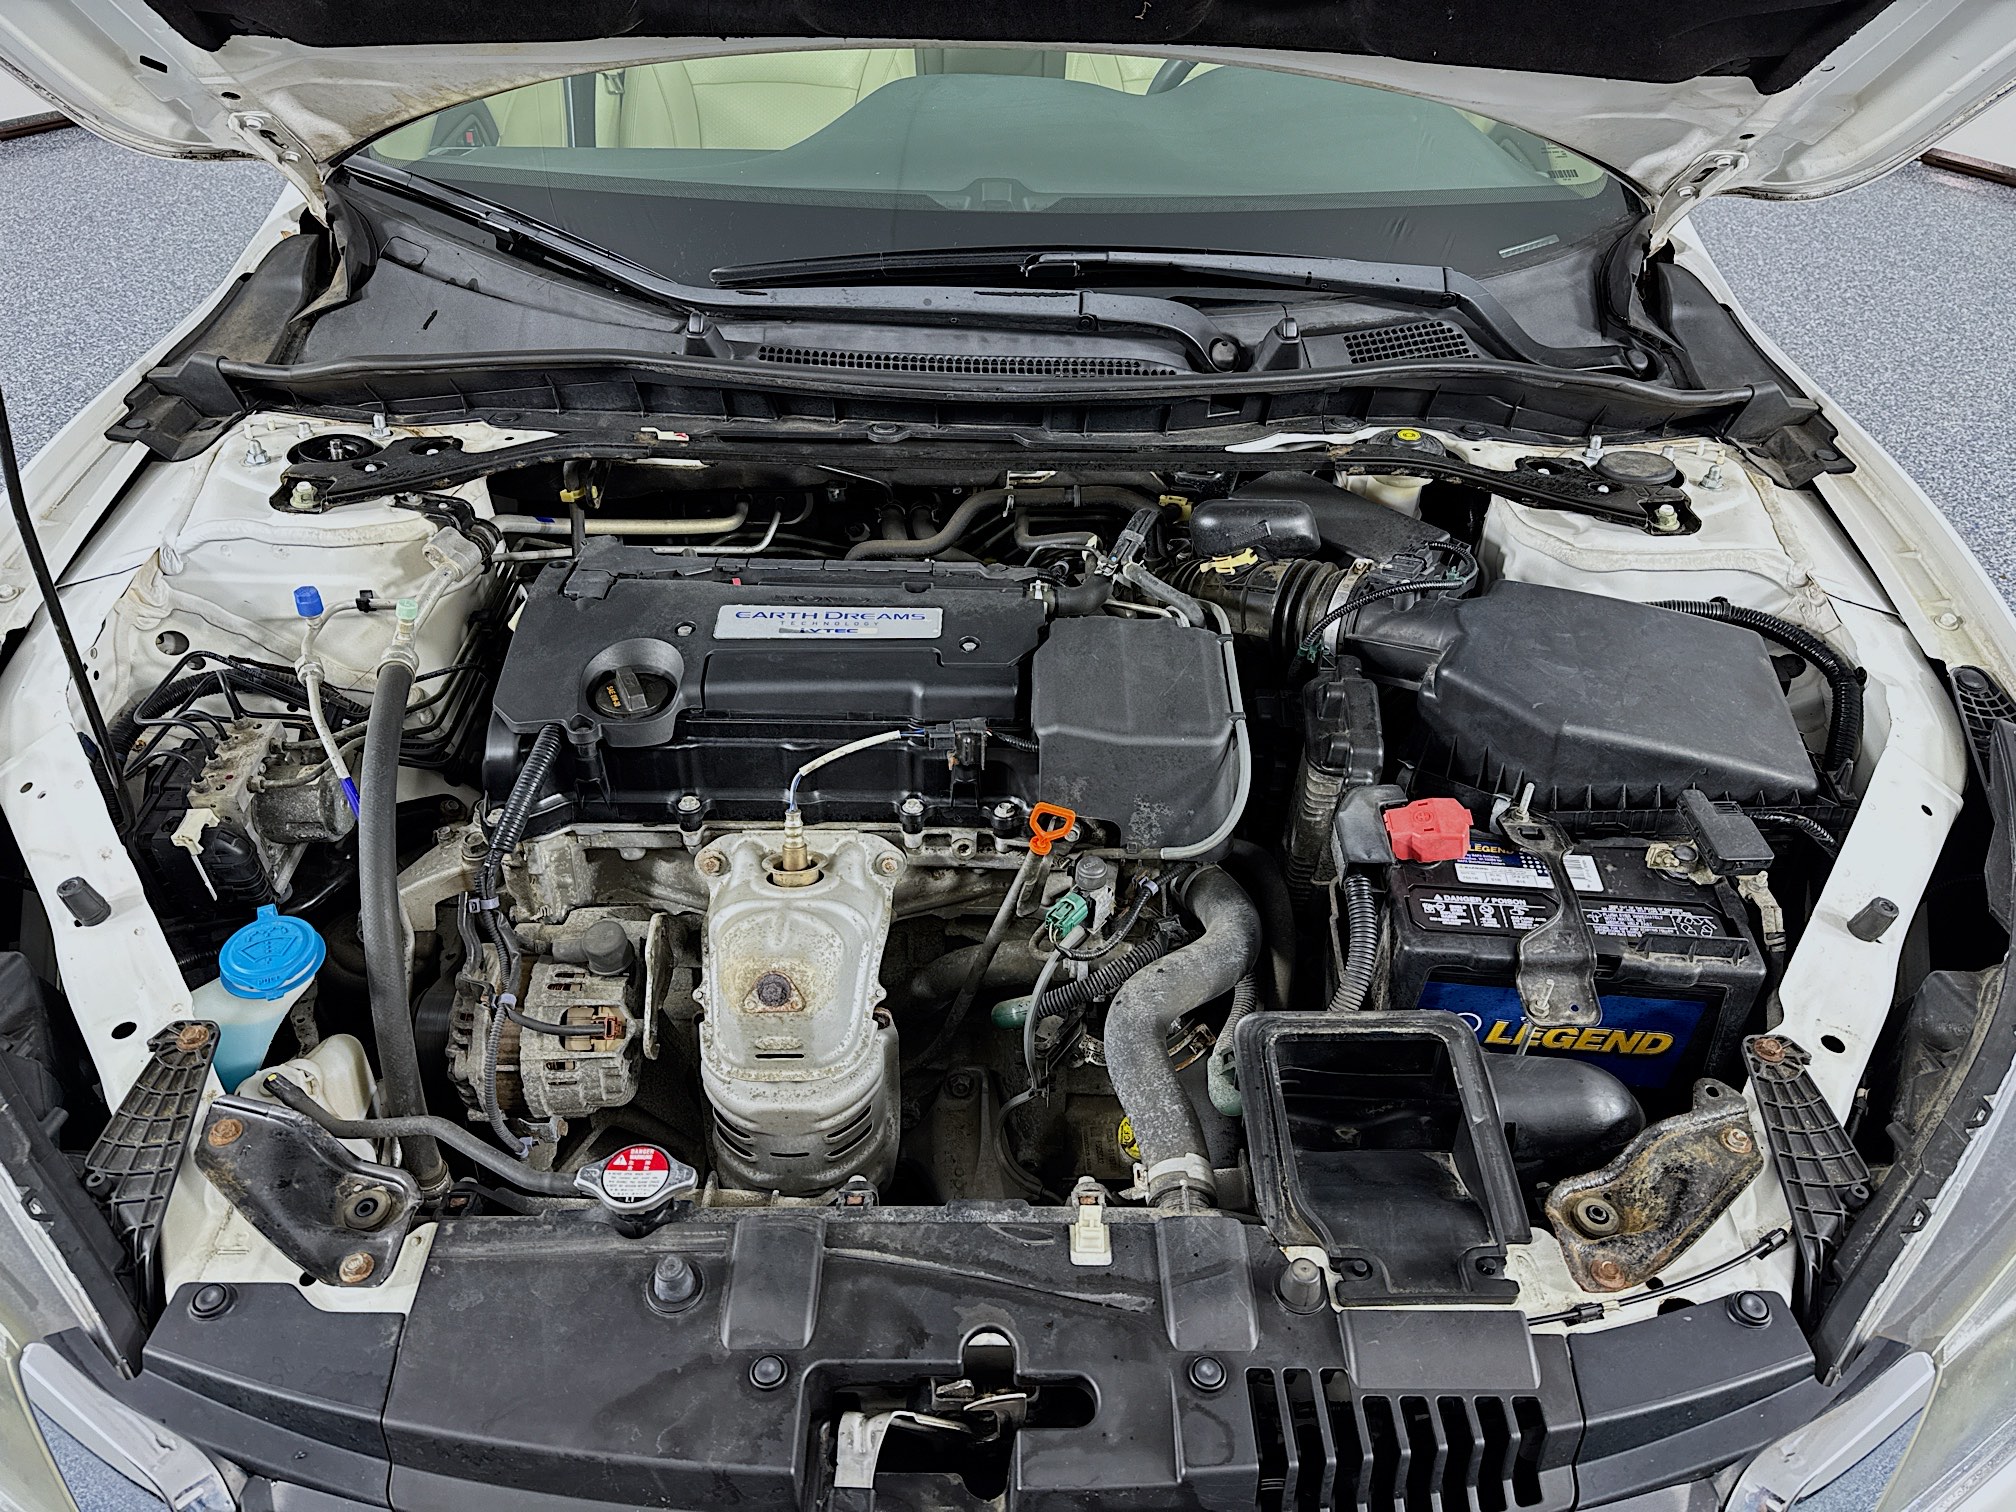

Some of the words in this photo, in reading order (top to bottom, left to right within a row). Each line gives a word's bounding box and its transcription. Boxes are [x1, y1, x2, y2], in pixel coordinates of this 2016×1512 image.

[735, 611, 818, 620] EARTH
[824, 611, 926, 621] DREAMS
[1443, 894, 1483, 904] DANGER
[1491, 897, 1527, 906] POISON
[1484, 1019, 1674, 1055] LEGEND
